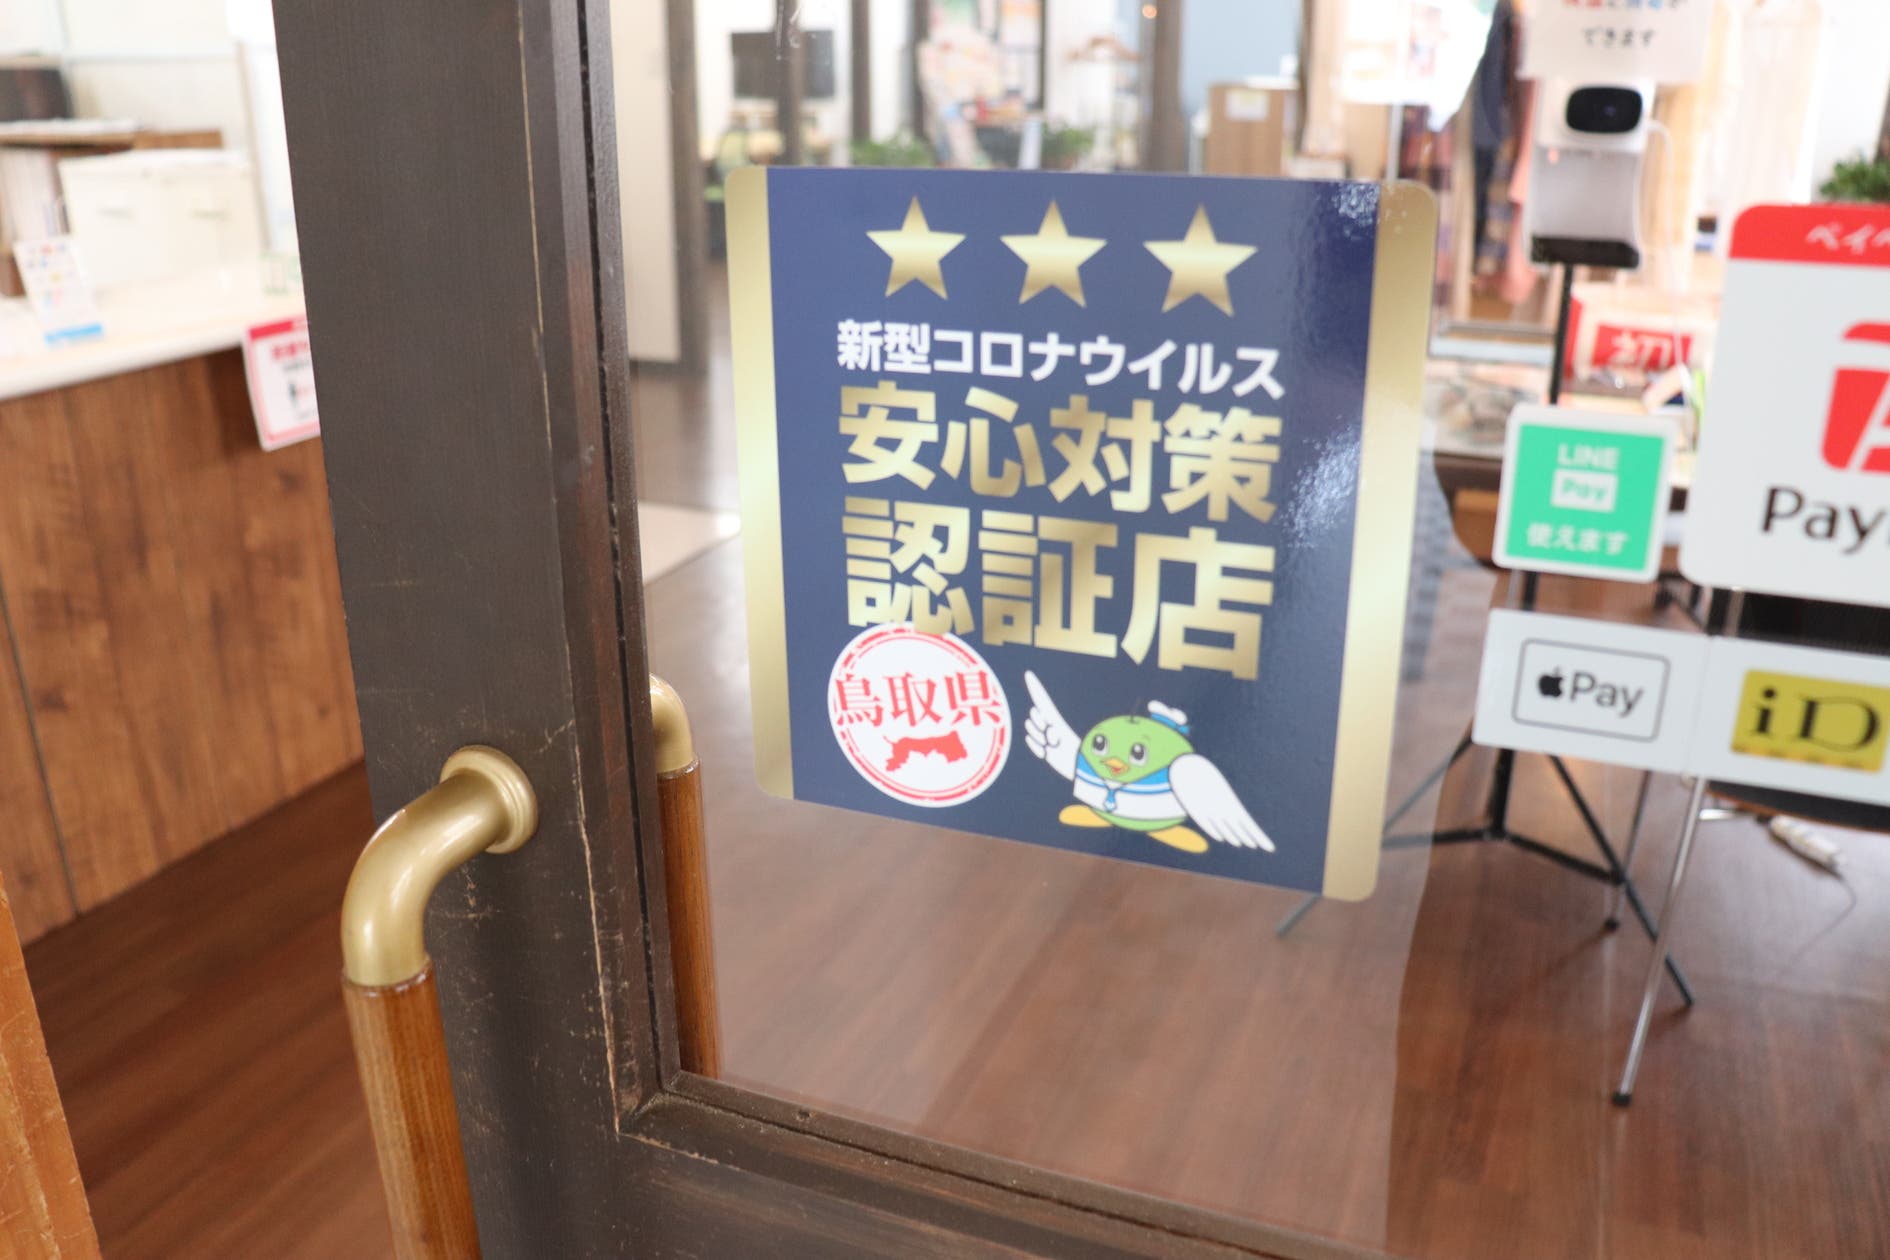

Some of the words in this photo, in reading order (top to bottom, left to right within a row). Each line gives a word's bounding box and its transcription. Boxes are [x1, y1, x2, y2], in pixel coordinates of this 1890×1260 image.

[836, 319, 1286, 400] 新型コロナウイルス
[838, 380, 1284, 523] 安心対策
[1556, 442, 1620, 470] LINE
[1561, 477, 1608, 504] Pay
[1762, 486, 1890, 556] Pay
[1527, 521, 1629, 556] 使えます
[842, 496, 1276, 680] 認証店
[835, 670, 1001, 727] 鳥取県
[1569, 671, 1643, 718] Pay
[1753, 687, 1881, 752] iD
